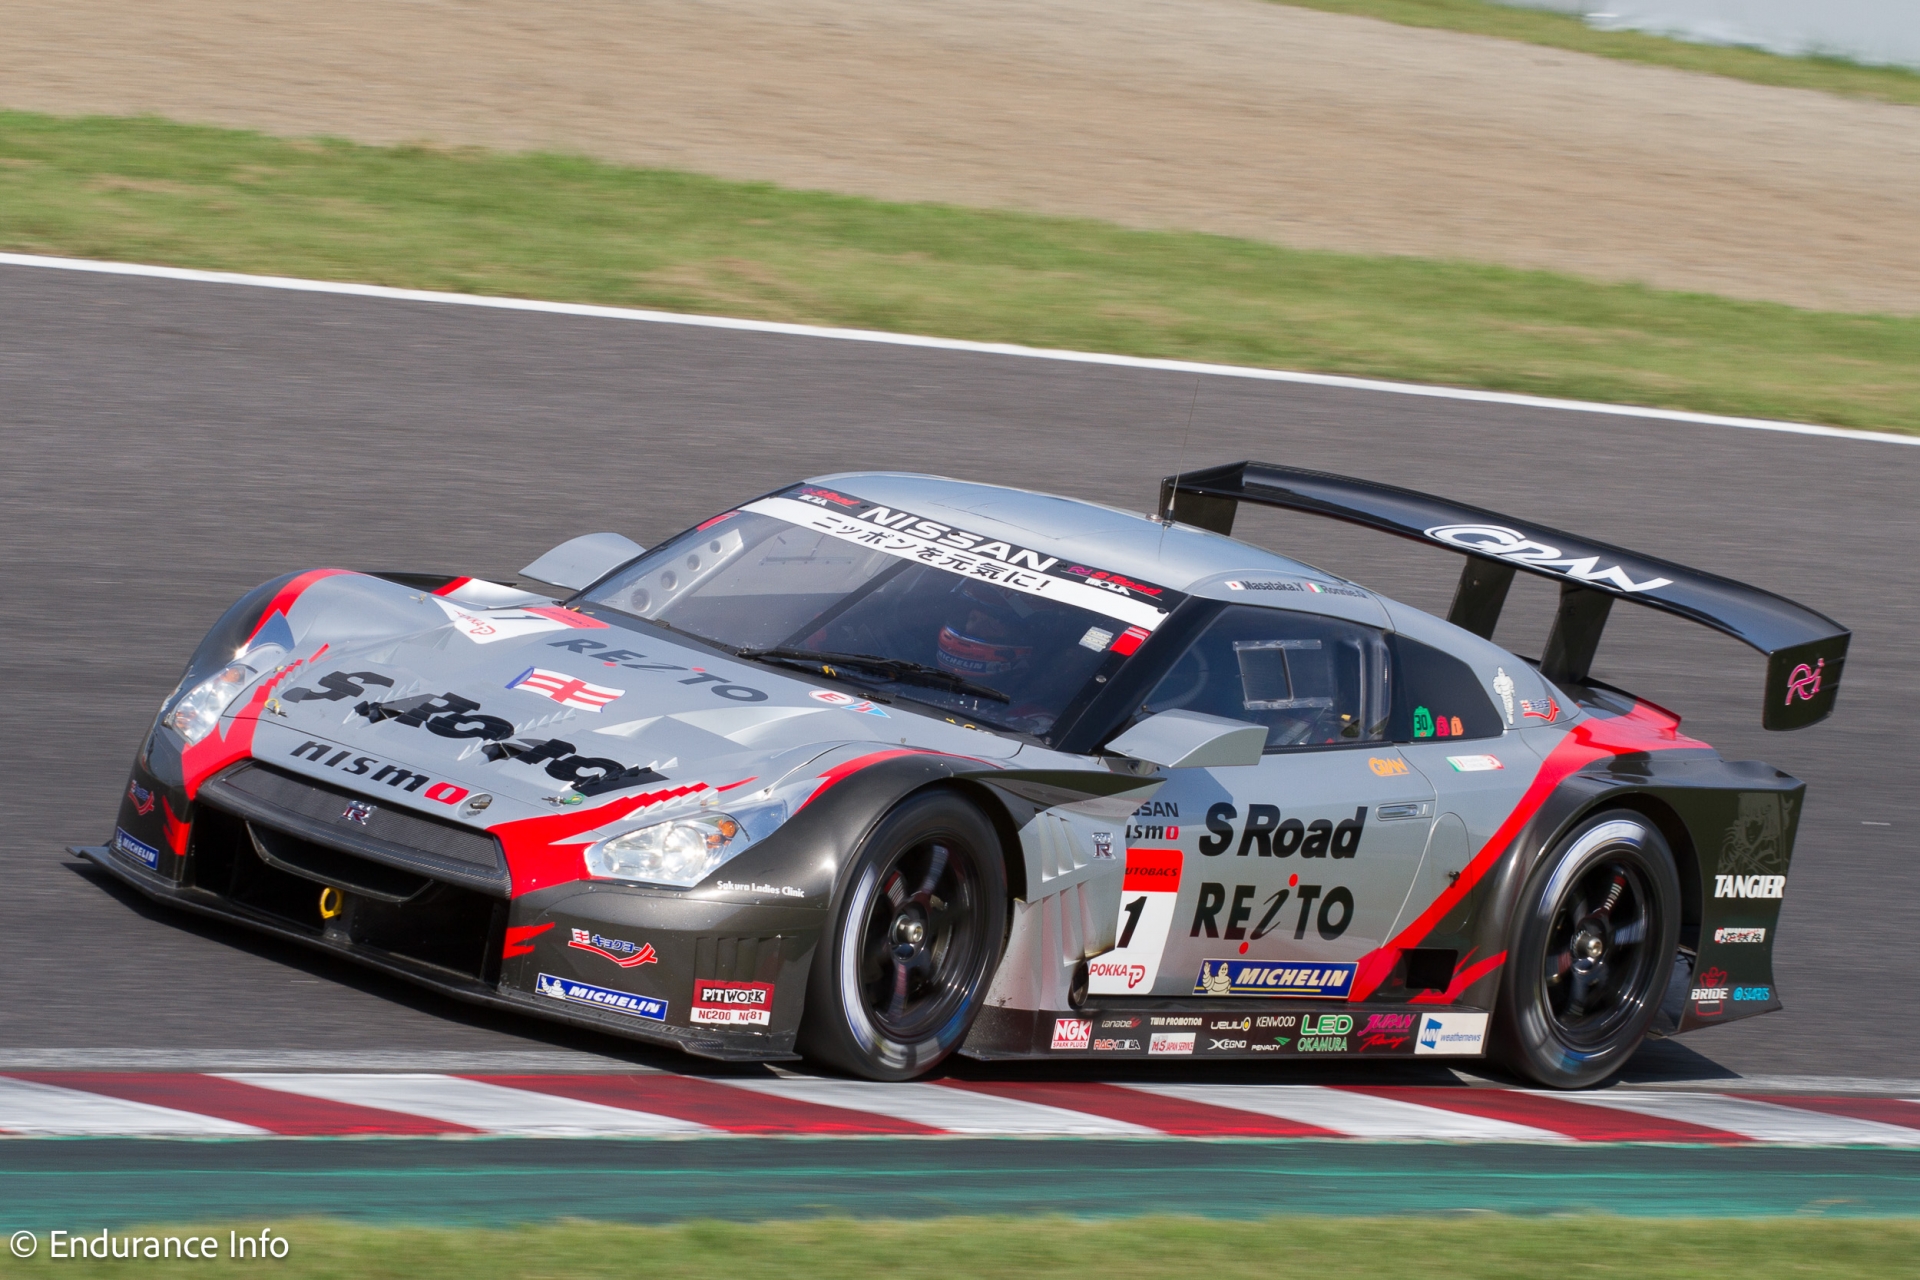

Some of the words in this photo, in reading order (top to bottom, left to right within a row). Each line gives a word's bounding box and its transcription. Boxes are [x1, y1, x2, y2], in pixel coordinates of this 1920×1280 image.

[857, 506, 1059, 572] NISSAN
[1414, 714, 1428, 731] 30
[290, 740, 470, 805] nismo
[1199, 802, 1238, 857] S
[1237, 805, 1368, 859] Road
[122, 838, 156, 862] MICHELIN
[717, 880, 750, 891] Sakura
[751, 883, 780, 894] Ladies
[781, 886, 805, 898] Clinic
[1714, 874, 1786, 899] TANGIER
[1116, 896, 1148, 949] 1
[1089, 963, 1127, 977] POKKA
[1235, 967, 1349, 988] MICHELIN
[568, 986, 662, 1014] MICHELIN
[1691, 988, 1729, 1000] BRIDE
[1054, 1020, 1090, 1041] NGK
[1256, 1016, 1296, 1027] KENWOOD
[1300, 1014, 1353, 1035] LED
[1297, 1037, 1348, 1052] OKAMURA
[1440, 1032, 1482, 1042] weathernews
